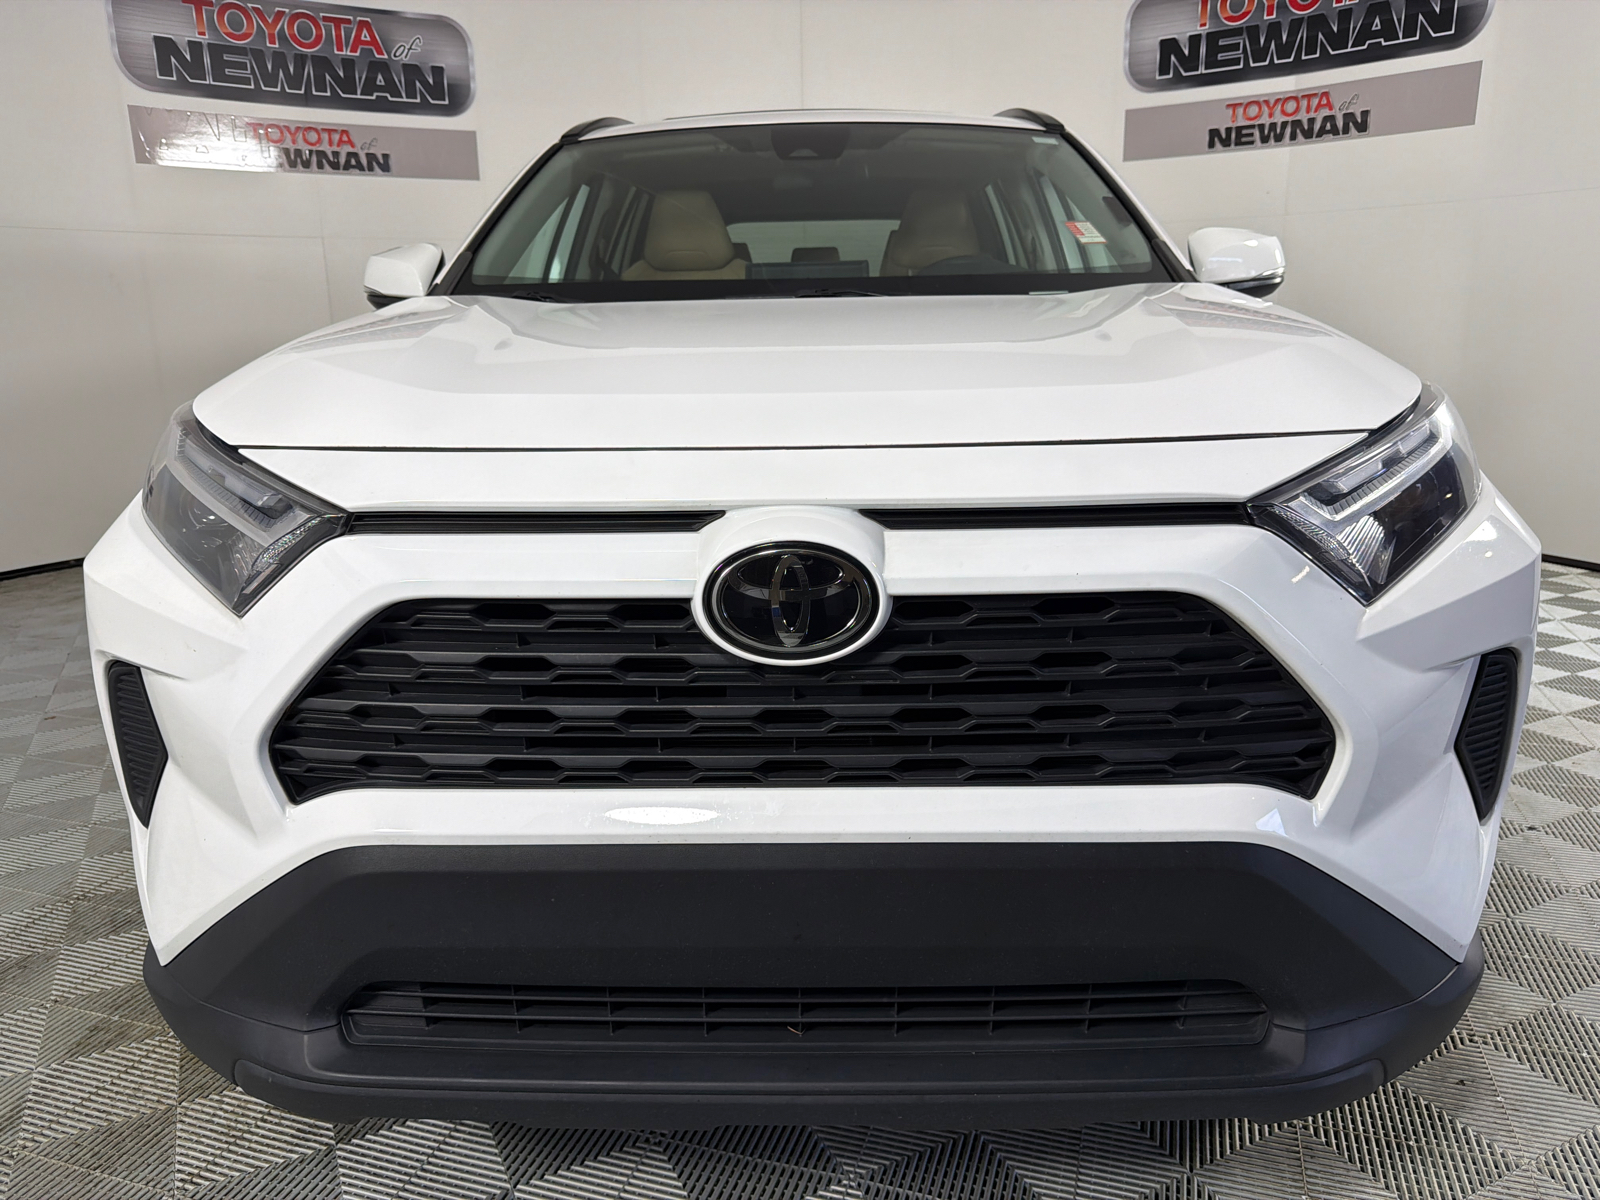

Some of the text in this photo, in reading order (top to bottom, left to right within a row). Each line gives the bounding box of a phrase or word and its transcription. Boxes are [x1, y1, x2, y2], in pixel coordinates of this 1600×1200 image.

[182, 0, 422, 61] TOYOTA of
[1156, 0, 1458, 80] NEWNAN
[151, 34, 449, 105] NEWNAN
[1225, 91, 1359, 124] TOYOTA of
[247, 121, 356, 149] TOYOTA
[1207, 109, 1370, 149] NEWNAN
[260, 146, 391, 173] WNAN
